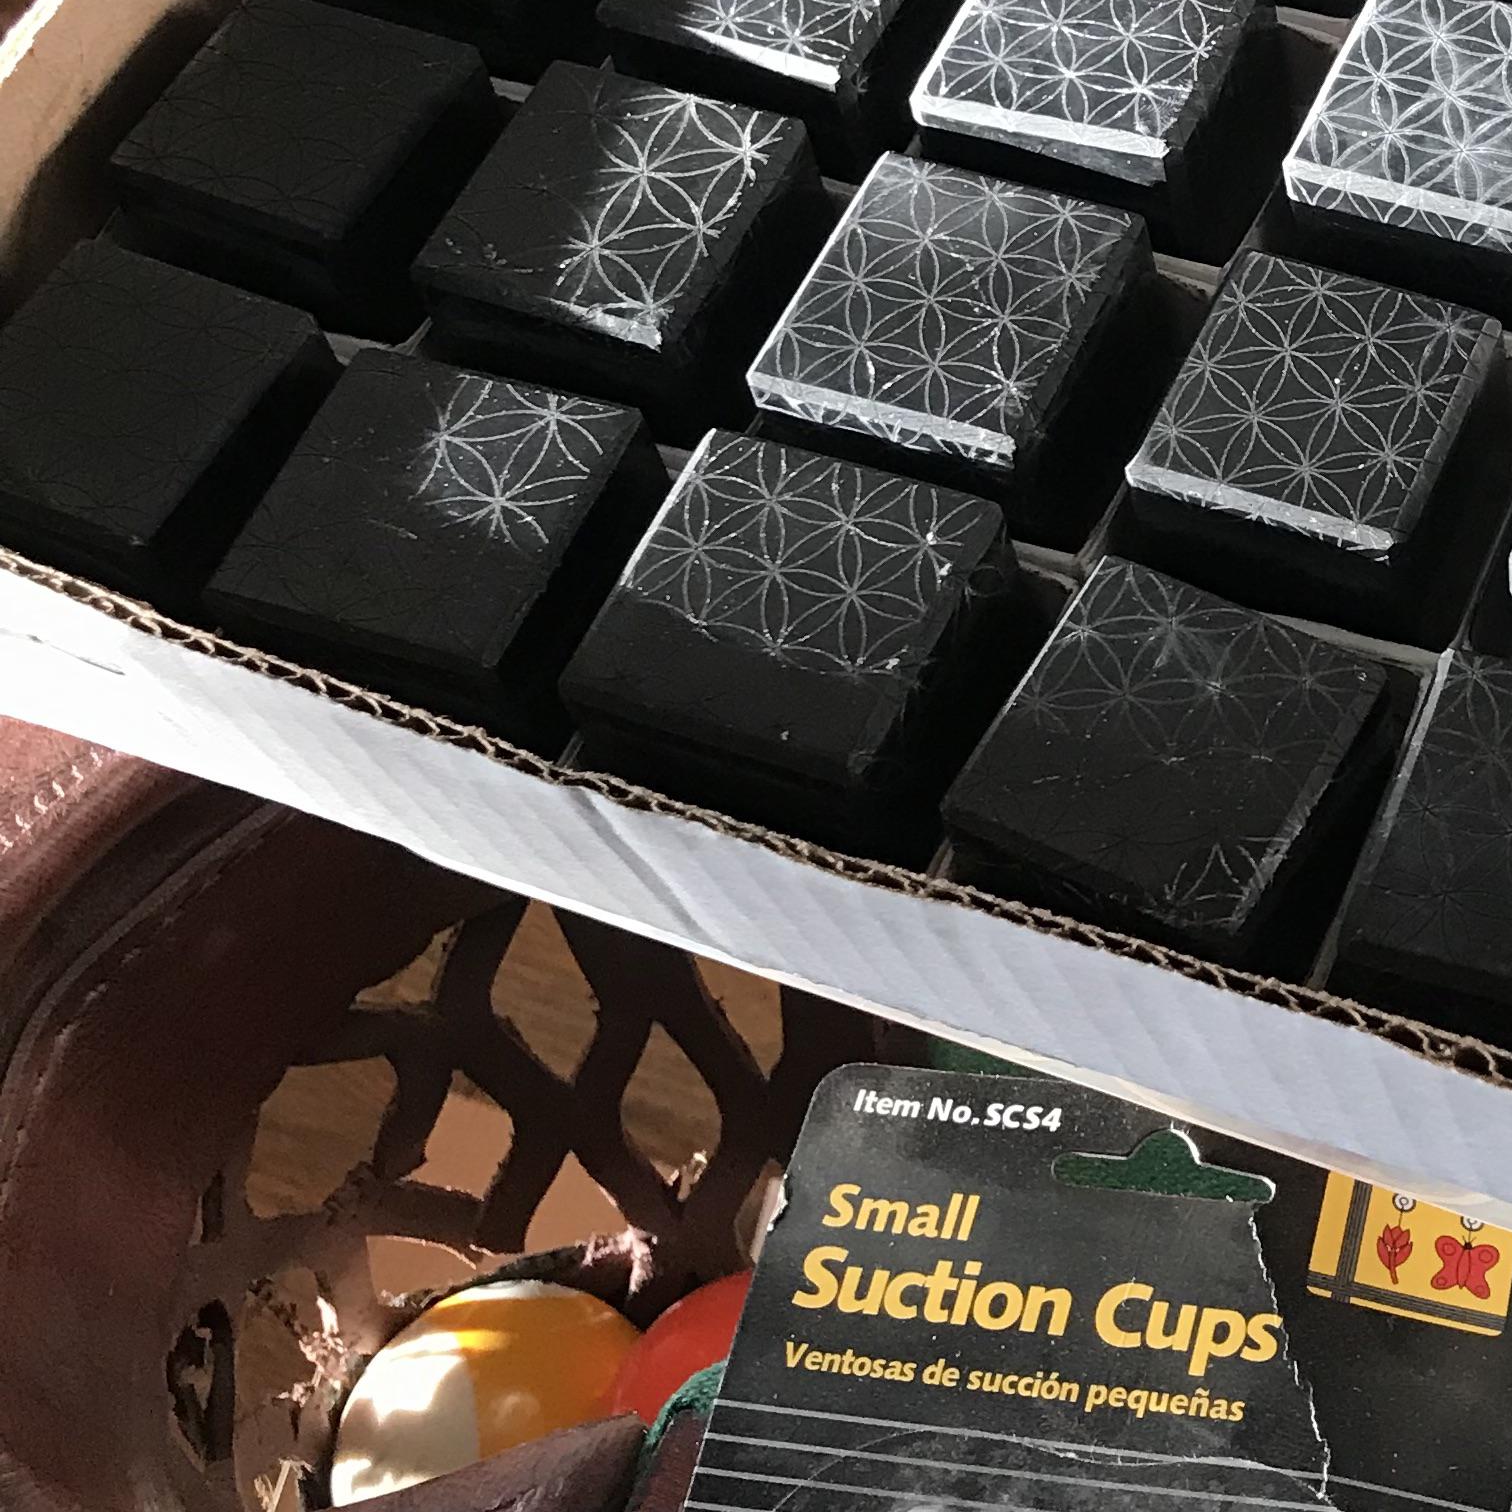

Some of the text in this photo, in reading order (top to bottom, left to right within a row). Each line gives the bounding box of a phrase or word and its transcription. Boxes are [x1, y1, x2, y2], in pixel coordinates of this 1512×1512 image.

[852, 1088, 921, 1118] Item
[821, 1183, 981, 1242] Small
[791, 1245, 1284, 1378] Suction Cups
[783, 1340, 1246, 1423] Ventosas de succión pequeñas
